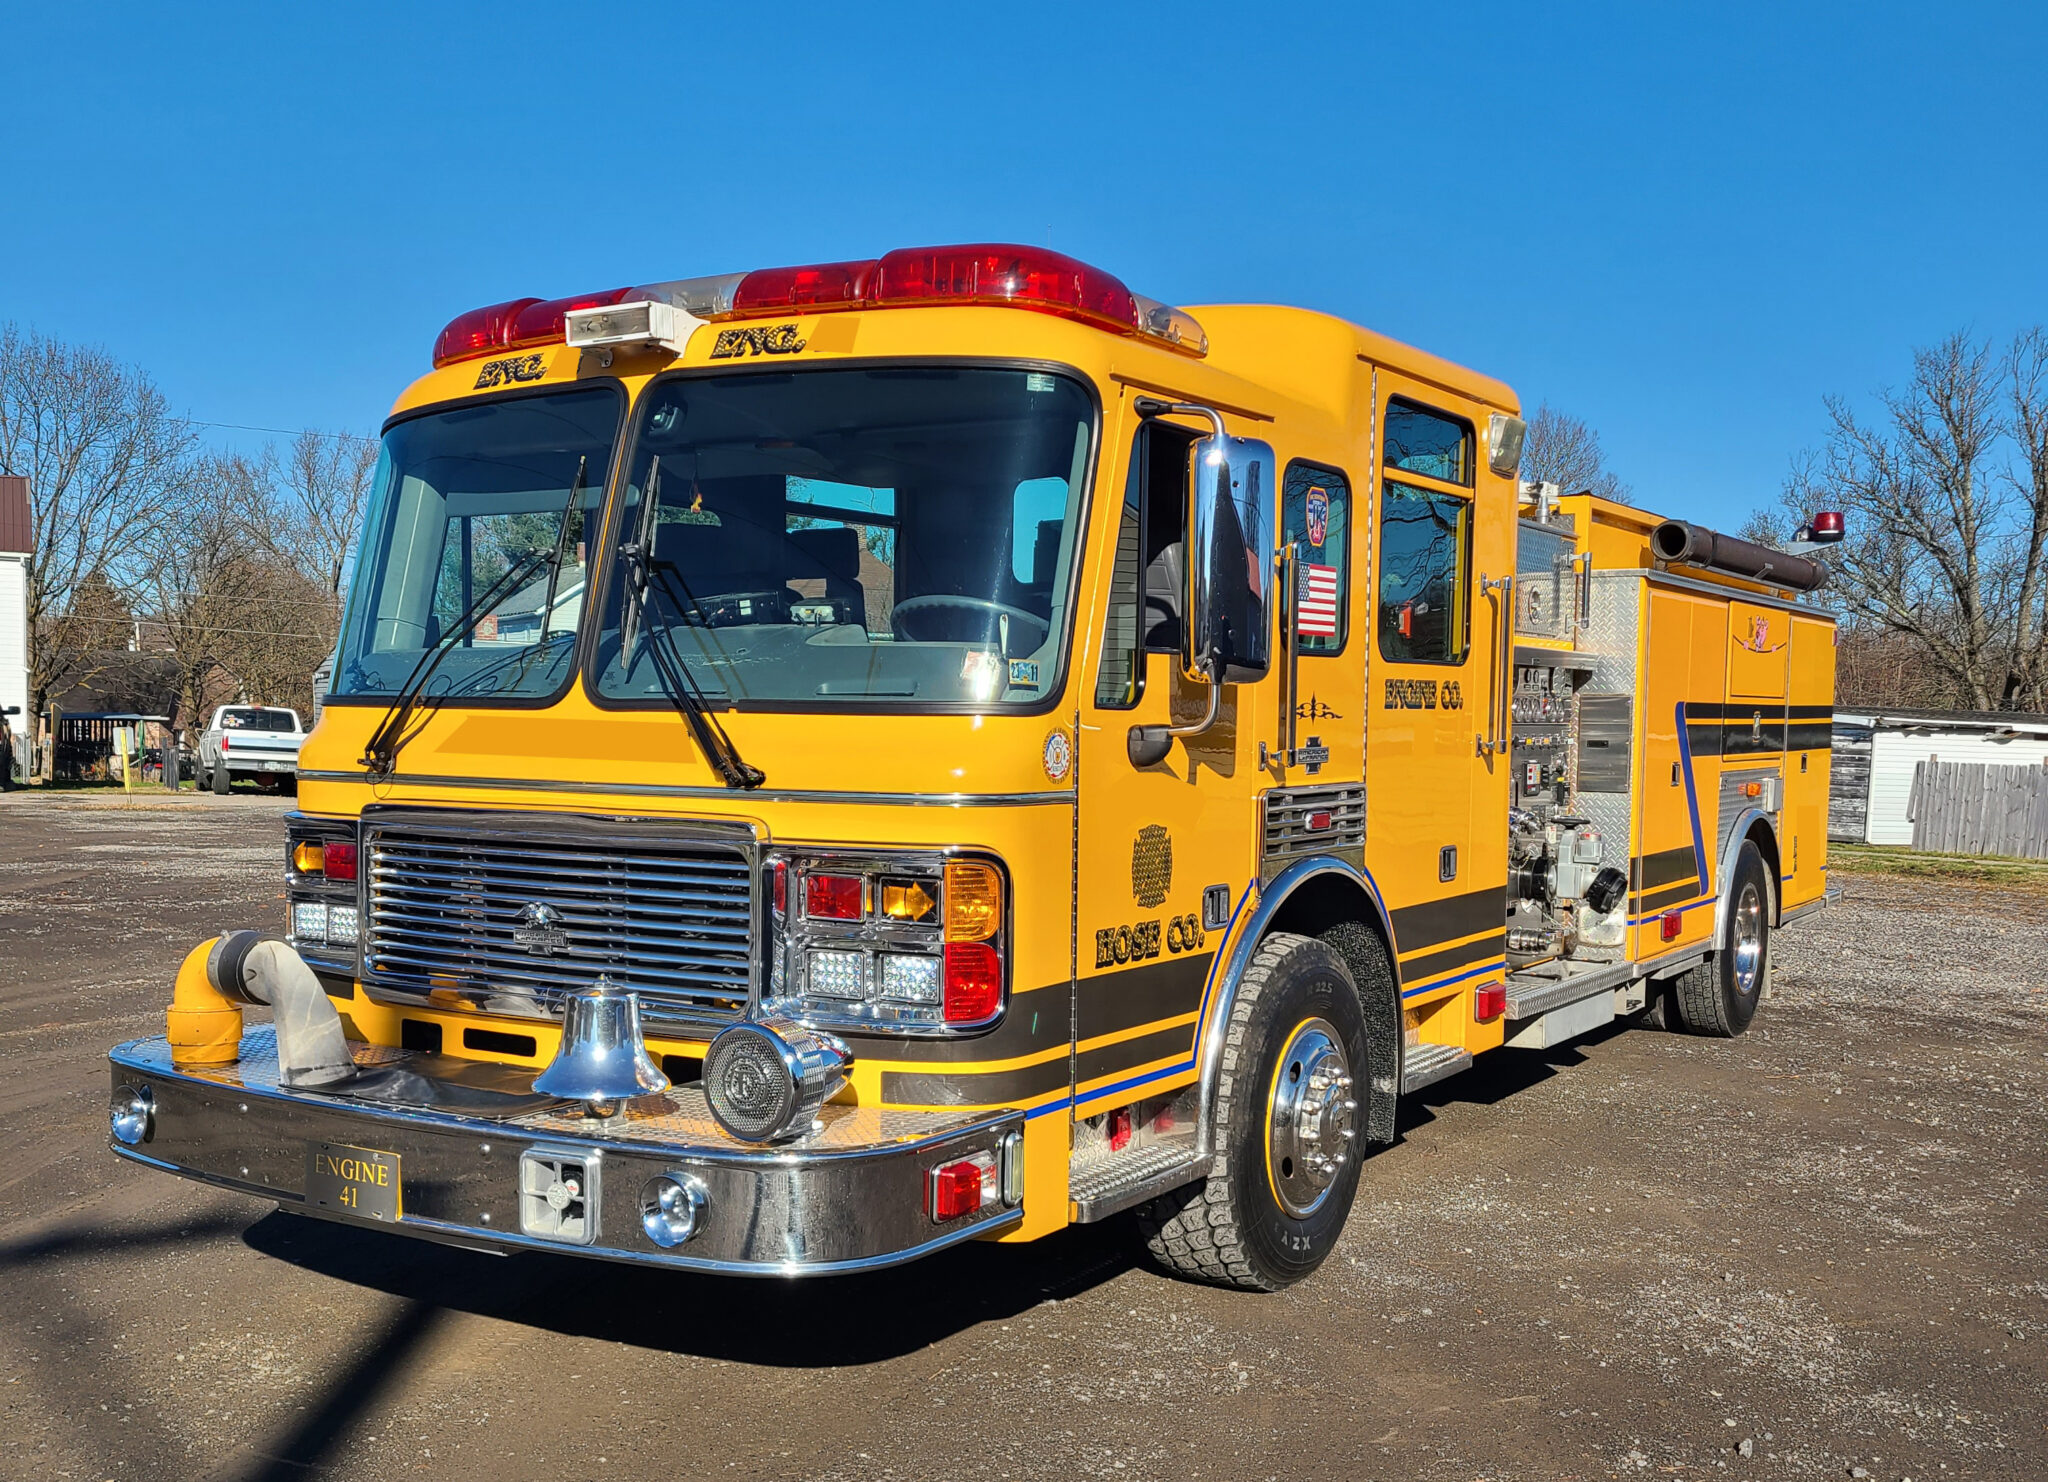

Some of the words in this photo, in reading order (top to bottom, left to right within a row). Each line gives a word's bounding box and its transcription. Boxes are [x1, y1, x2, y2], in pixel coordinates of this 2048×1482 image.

[709, 323, 807, 360] ENG.
[472, 352, 548, 390] ENG.
[1384, 678, 1438, 710] ENGINE
[1441, 680, 1464, 710] CO.
[1095, 919, 1162, 969] HOSE
[1167, 913, 1205, 954] CO.
[315, 1153, 389, 1187] ENGINE
[339, 1185, 358, 1208] 41
